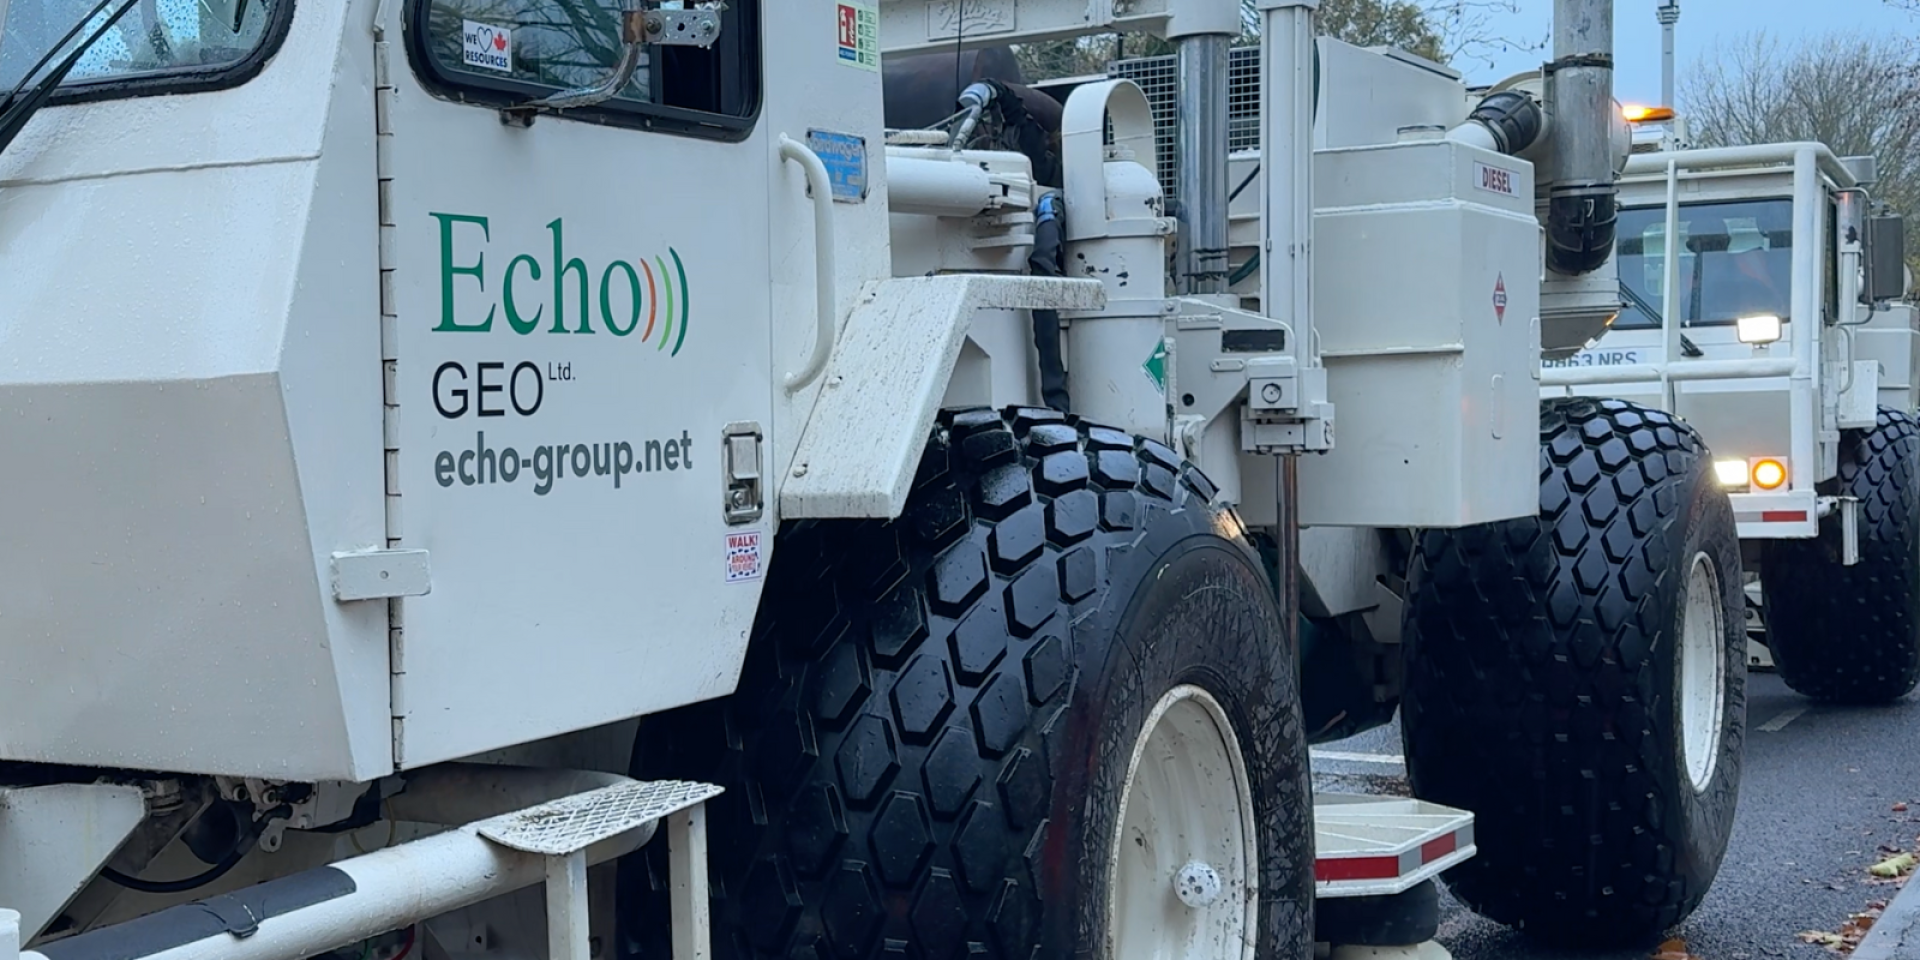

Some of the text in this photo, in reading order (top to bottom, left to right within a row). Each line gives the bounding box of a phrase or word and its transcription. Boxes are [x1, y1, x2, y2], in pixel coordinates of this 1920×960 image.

[465, 33, 477, 44] WE
[466, 50, 507, 67] RESOURCES
[1482, 166, 1511, 193] DIESEL
[428, 211, 642, 337] Echo
[1598, 351, 1637, 367] NRS
[431, 360, 576, 419] GEO Ltd.
[434, 430, 693, 496] echo-group.net
[729, 535, 757, 547] WALK!
